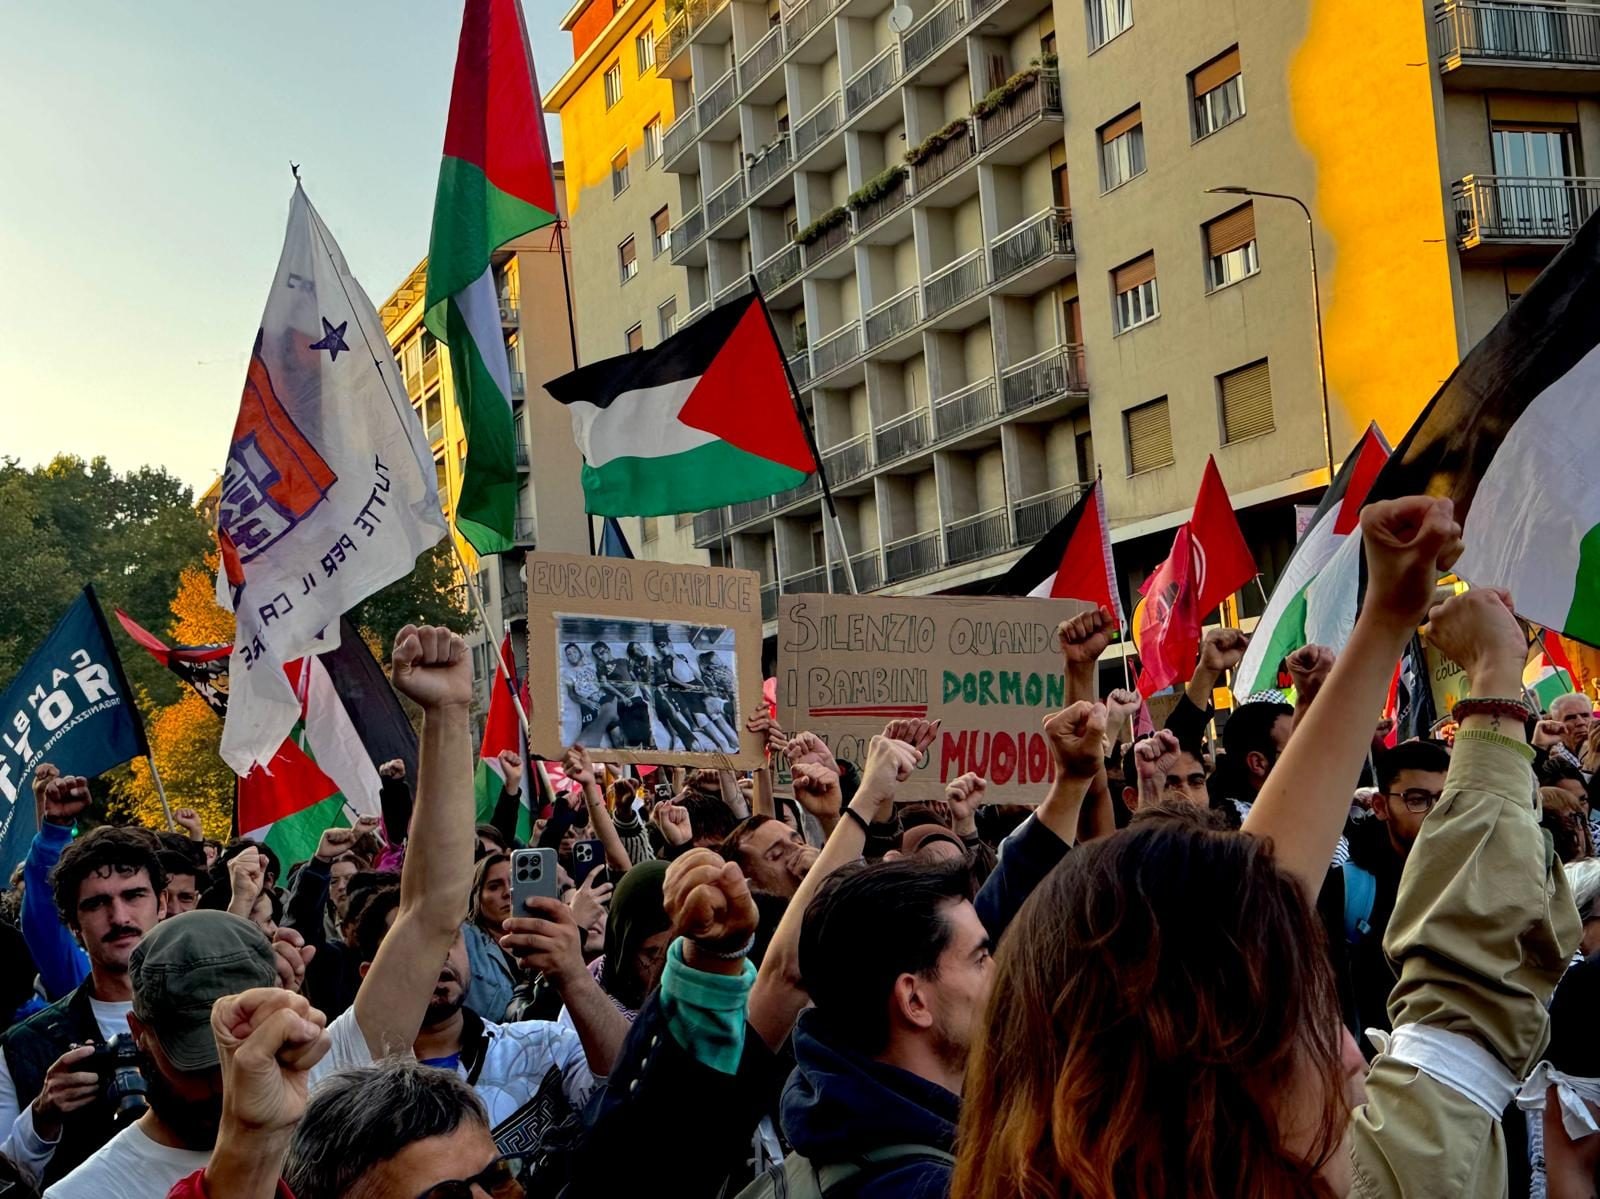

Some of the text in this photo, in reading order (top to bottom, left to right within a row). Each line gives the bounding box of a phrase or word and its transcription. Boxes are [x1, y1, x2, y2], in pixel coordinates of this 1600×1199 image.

[532, 561, 752, 613] EUROPA COMPLICE
[784, 603, 936, 653] SILENZIO
[787, 667, 1065, 708] I BAMBINI DORMON
[940, 729, 1056, 786] MUOIO
